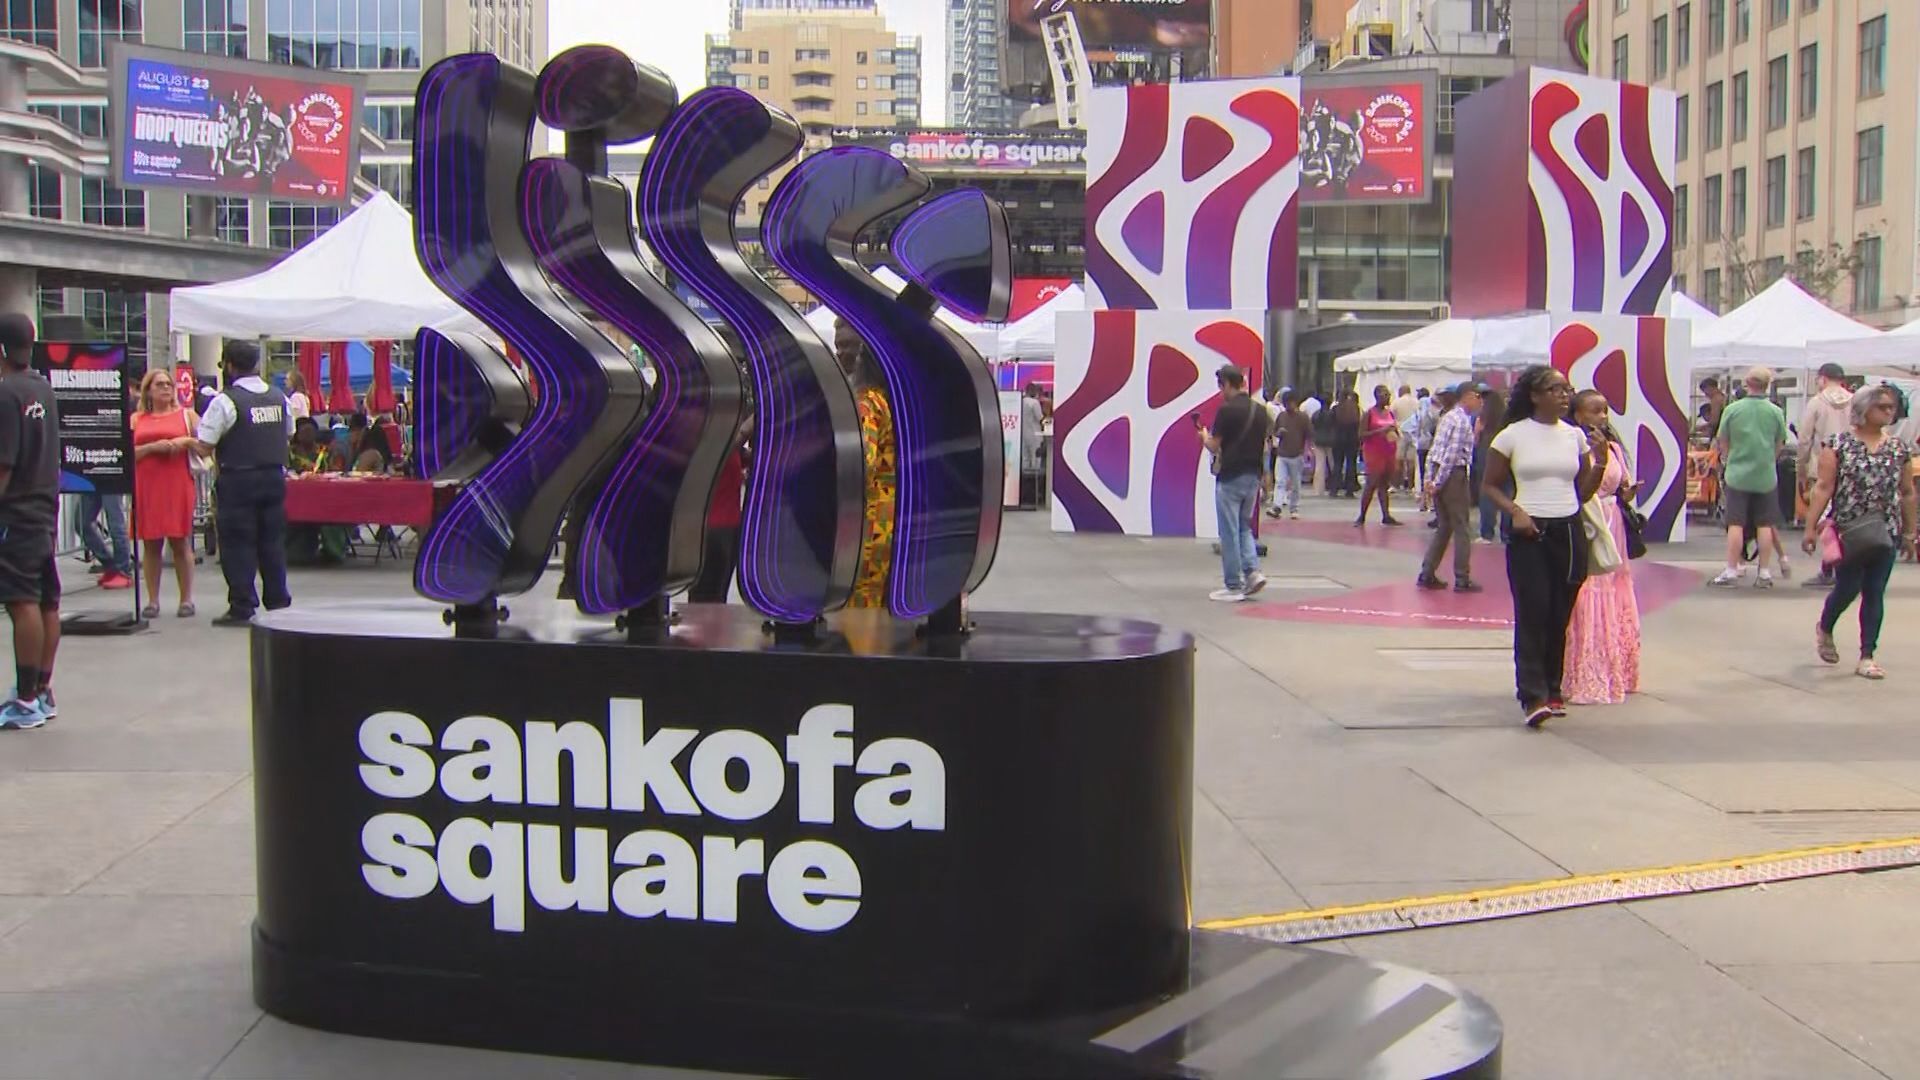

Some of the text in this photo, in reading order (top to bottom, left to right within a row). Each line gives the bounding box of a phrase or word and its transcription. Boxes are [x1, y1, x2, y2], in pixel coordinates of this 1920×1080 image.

[138, 71, 209, 90] AUGUST 23
[135, 113, 228, 149] HOOPQUEENS
[298, 93, 343, 120] SANKOFA
[324, 121, 343, 144] DAY
[1365, 93, 1413, 118] SANKOFA
[1395, 120, 1413, 143] DAY
[890, 139, 999, 160] sankofa
[50, 369, 121, 389] WASHROOMS
[250, 405, 282, 424] SECURITY
[359, 697, 947, 831] sankofa
[361, 812, 863, 933] square
